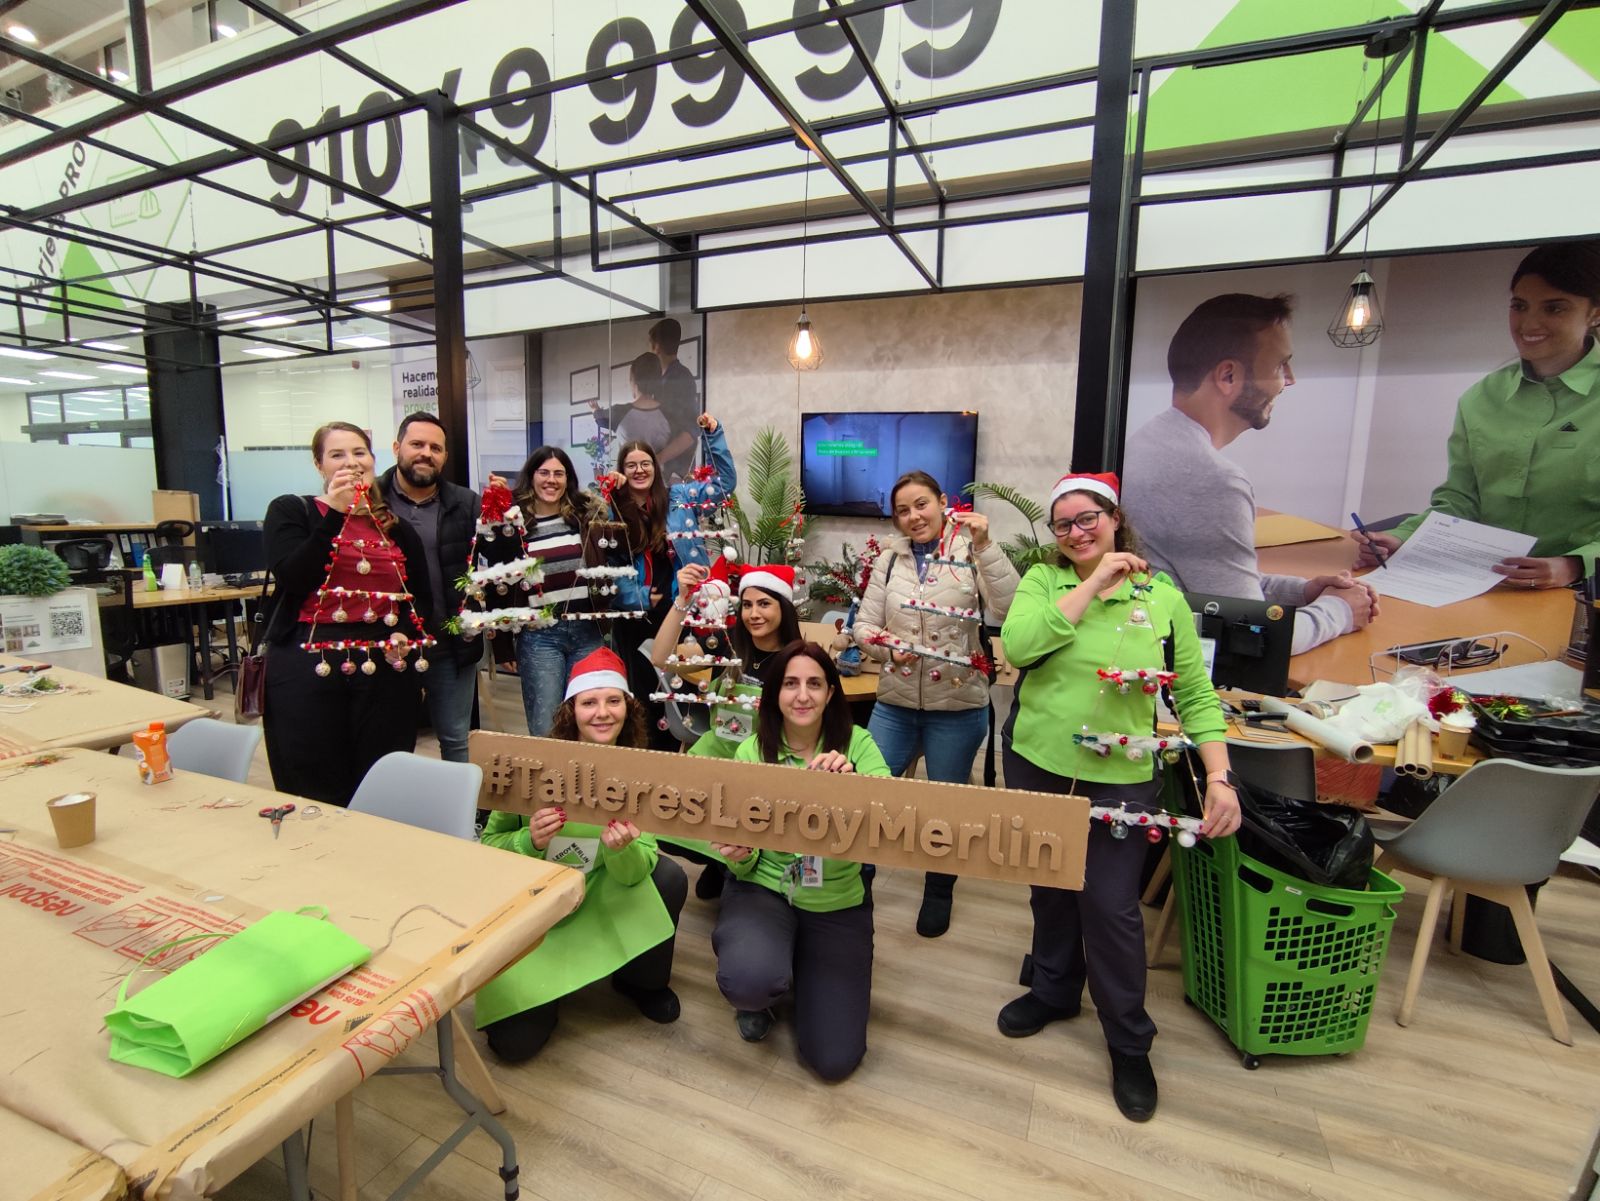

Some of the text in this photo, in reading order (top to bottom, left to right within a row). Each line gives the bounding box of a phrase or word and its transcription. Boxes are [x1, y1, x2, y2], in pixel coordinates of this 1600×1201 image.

[266, 91, 402, 216] 910
[586, 0, 748, 145] 99
[793, 0, 1000, 101] 99
[402, 371, 438, 383] Hacem
[483, 753, 1063, 871] #TalleresLeroyMerlin
